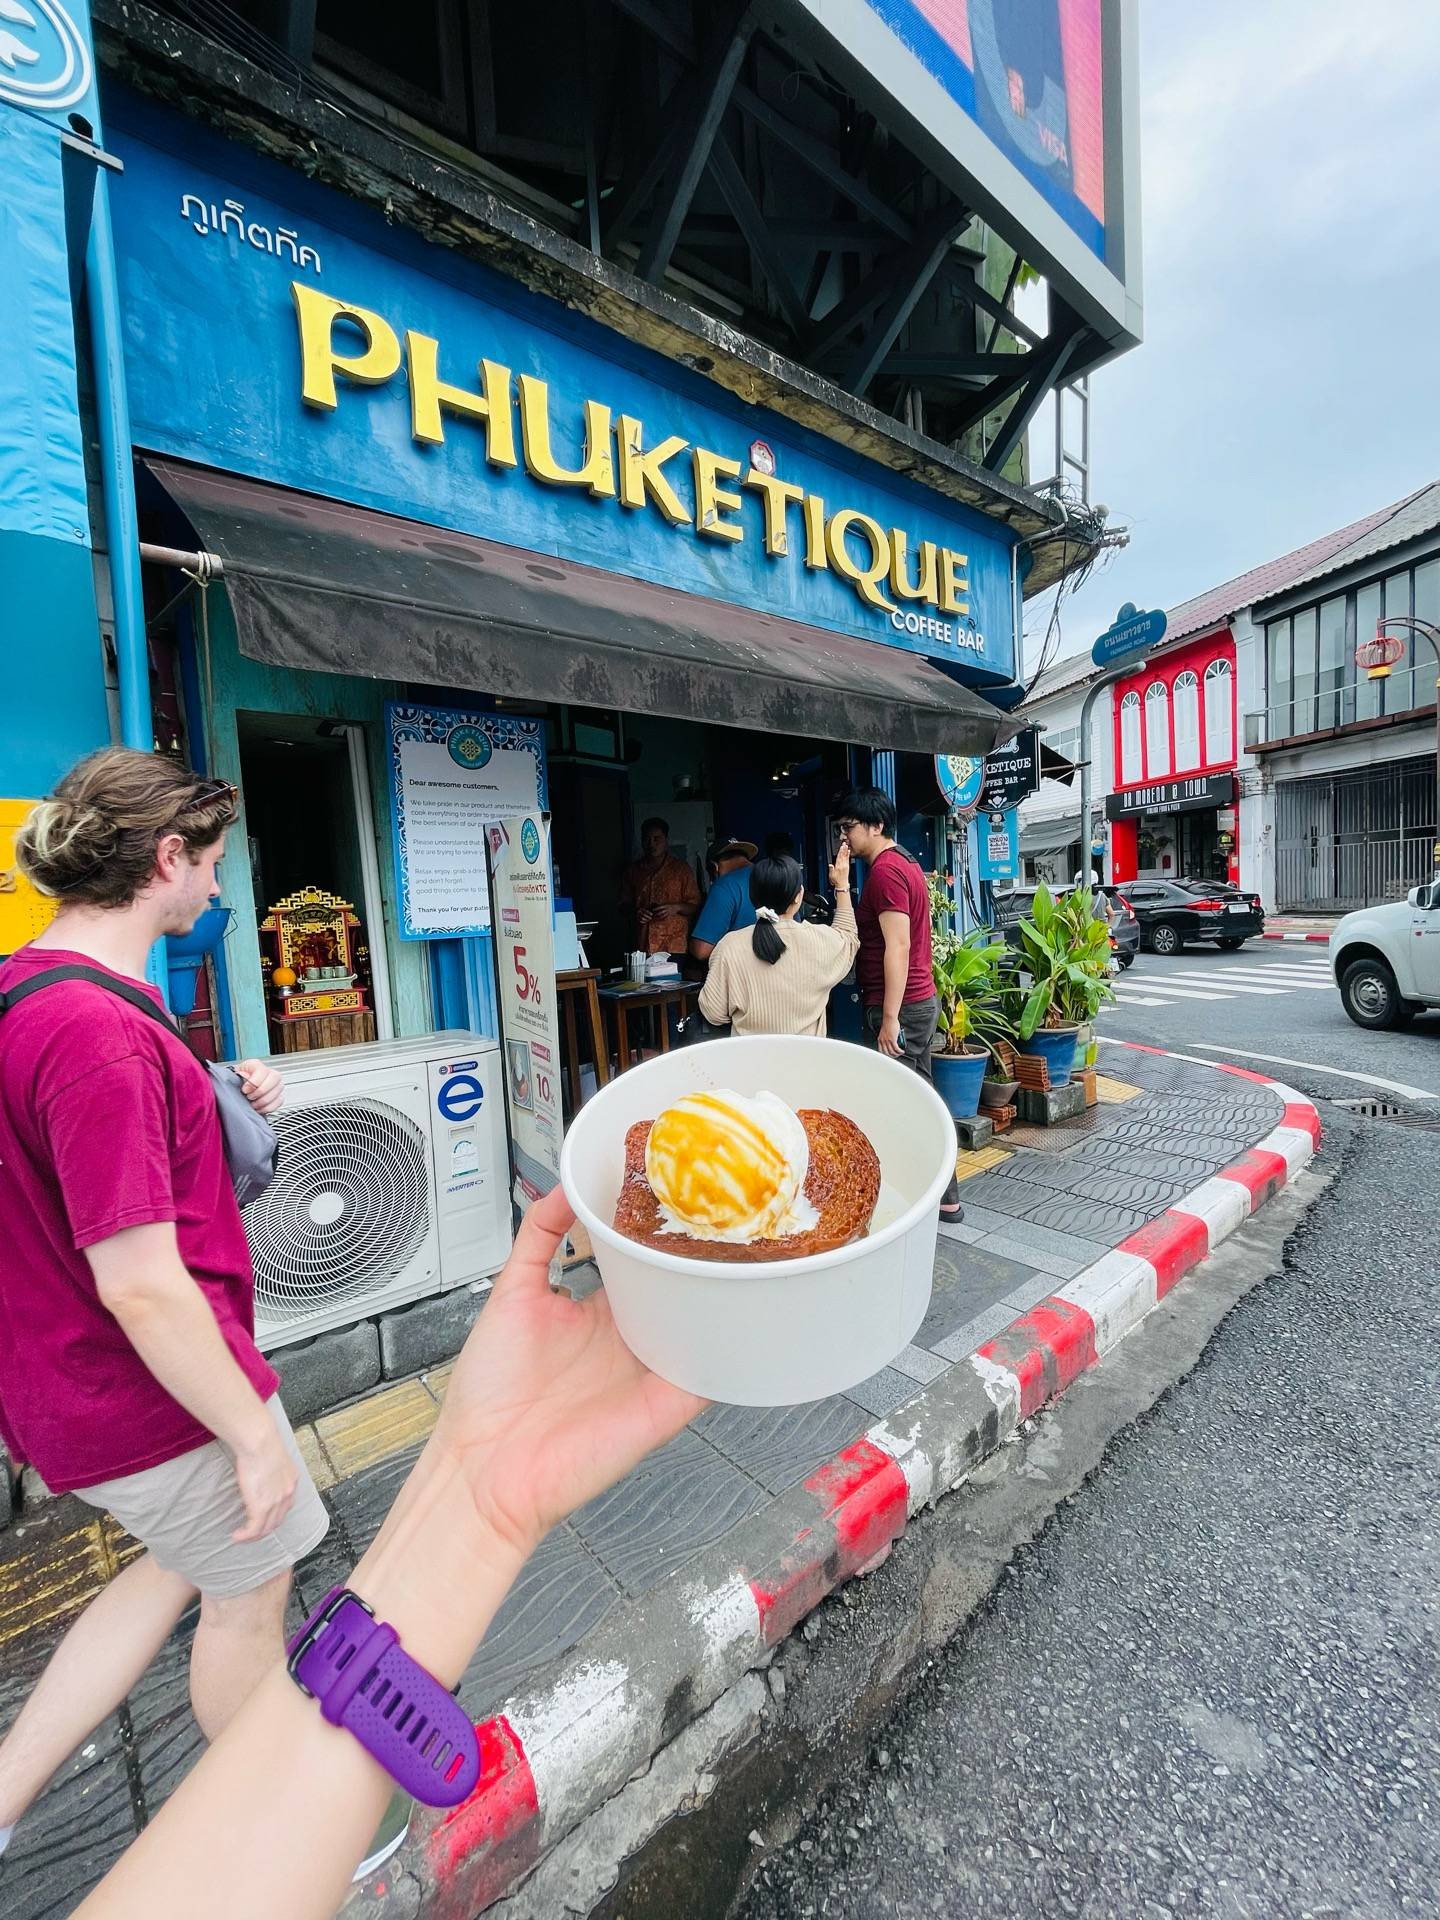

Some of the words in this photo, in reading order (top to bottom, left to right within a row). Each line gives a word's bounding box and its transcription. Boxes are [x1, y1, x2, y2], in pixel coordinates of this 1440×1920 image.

[181, 194, 321, 273] ภูเก็ตทีค
[292, 281, 971, 617] PHUKETIQUE
[891, 608, 952, 643] COFFEE
[957, 627, 984, 653] BAR
[986, 757, 1031, 774] KETIQUE
[409, 779, 426, 787] Dear
[428, 781, 461, 789] awesome
[1005, 776, 1019, 784] BAR
[471, 803, 493, 811] product
[427, 809, 460, 819] everything
[536, 884, 547, 893] KTC
[474, 905, 489, 913] patie
[513, 945, 541, 1005] 5%
[447, 1181, 475, 1193] INVERTER
